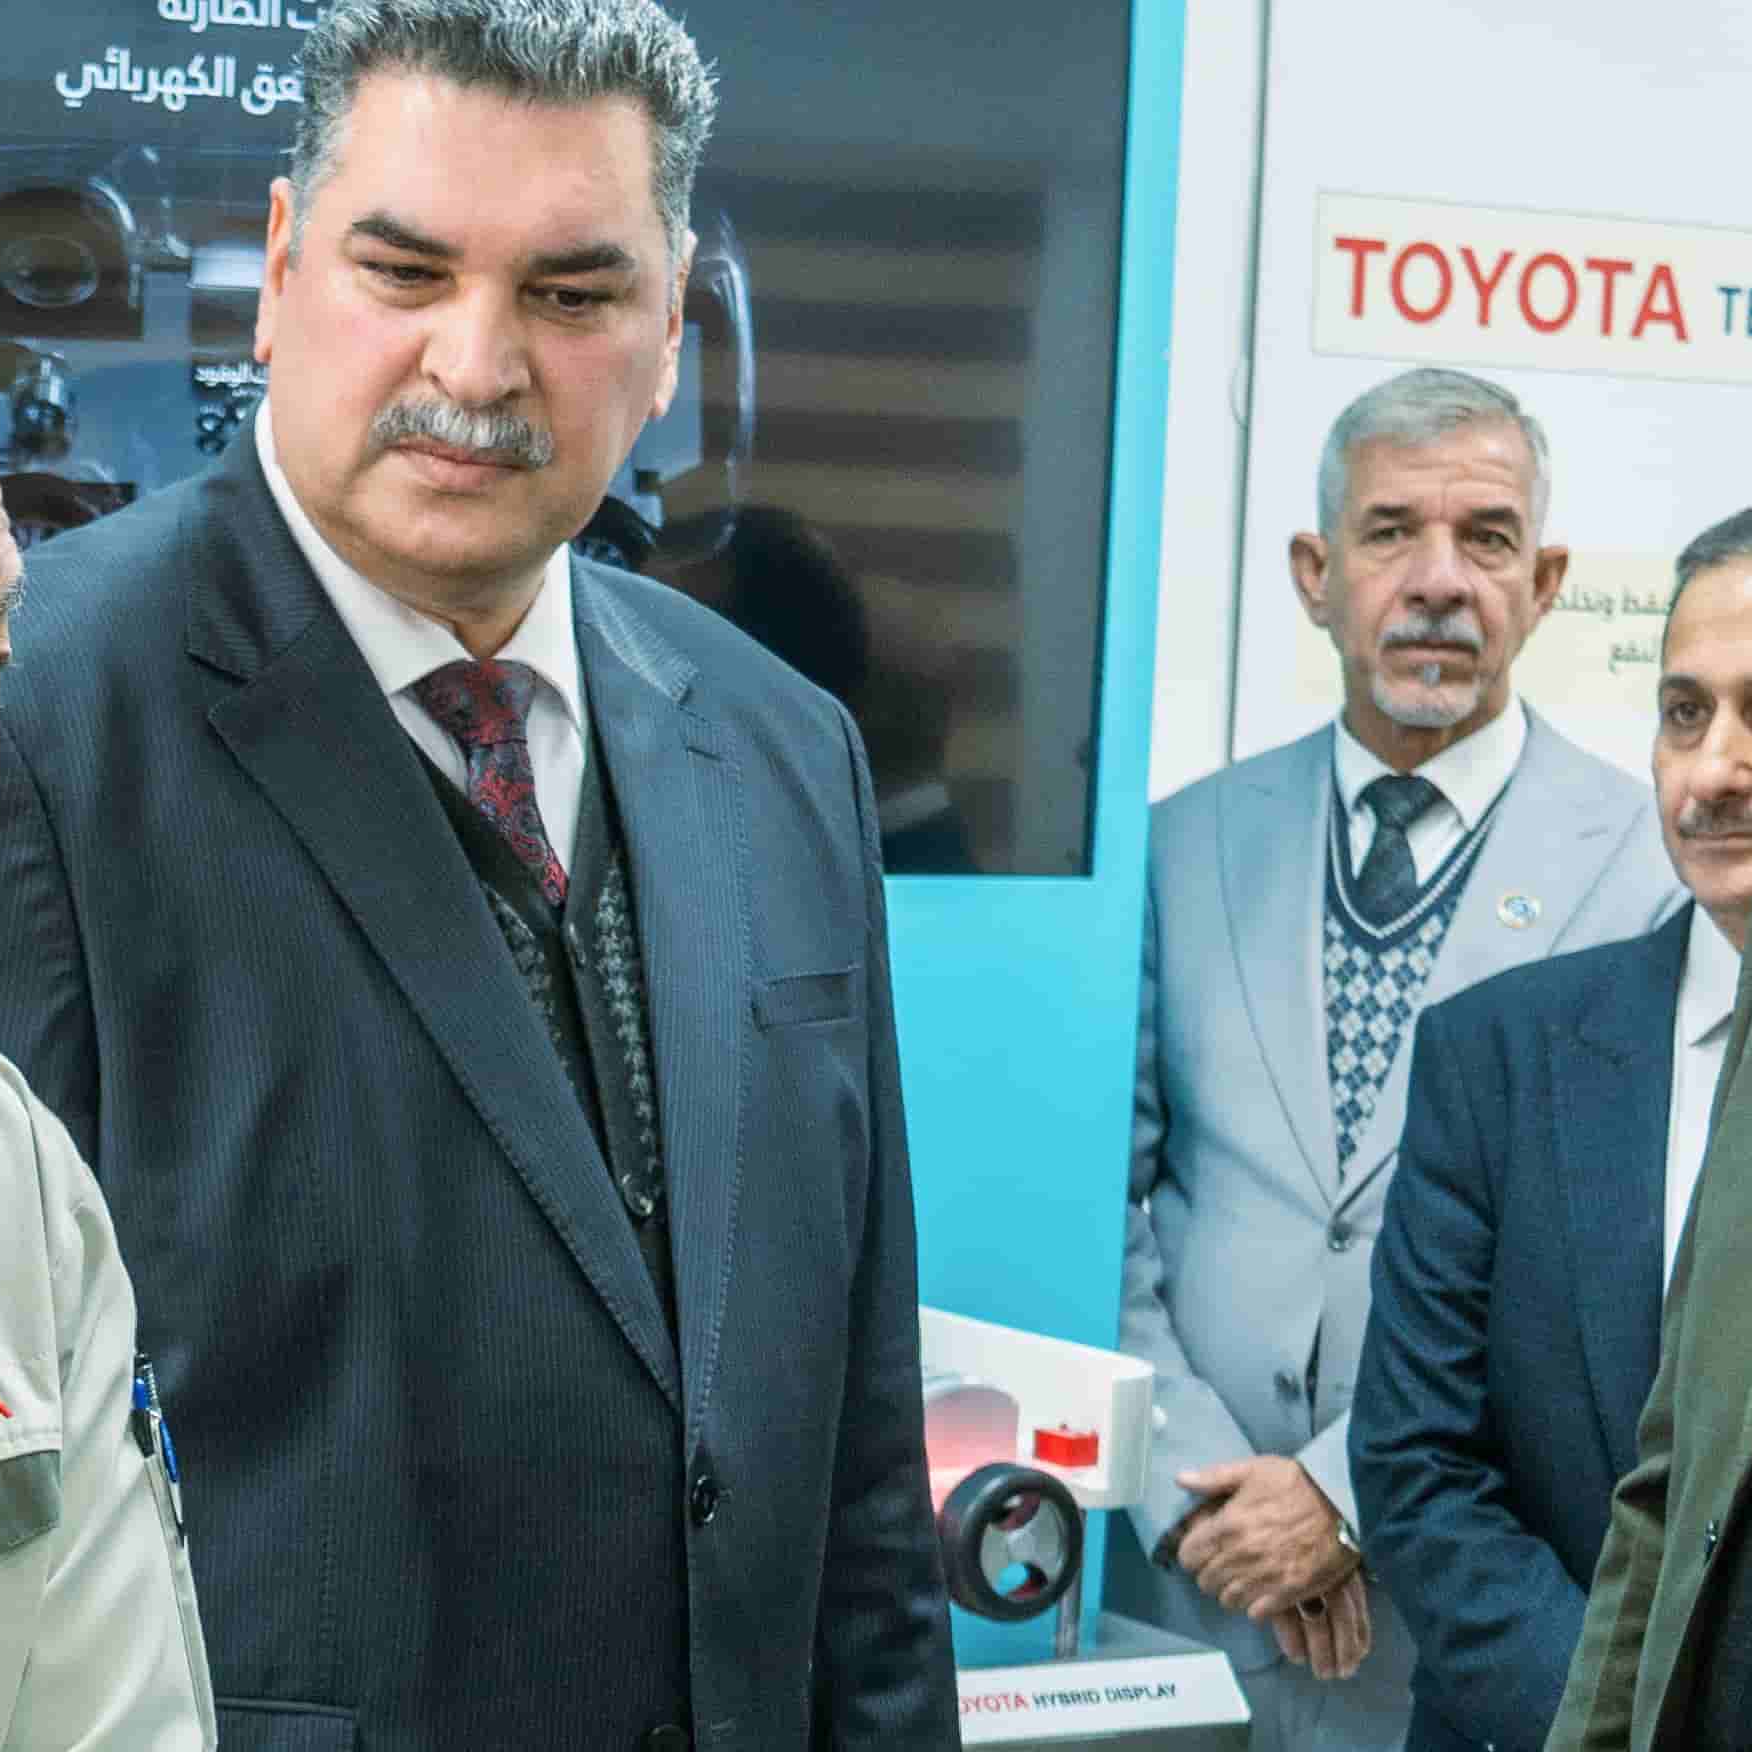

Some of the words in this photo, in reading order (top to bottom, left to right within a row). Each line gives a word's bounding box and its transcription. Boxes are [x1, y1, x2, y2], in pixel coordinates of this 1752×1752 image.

[55, 46, 236, 111] الكهربائي
[1334, 236, 1690, 344] TOYOTA
[1033, 1687, 1101, 1710] HYBRID
[1105, 1683, 1177, 1704] DISPLAY
